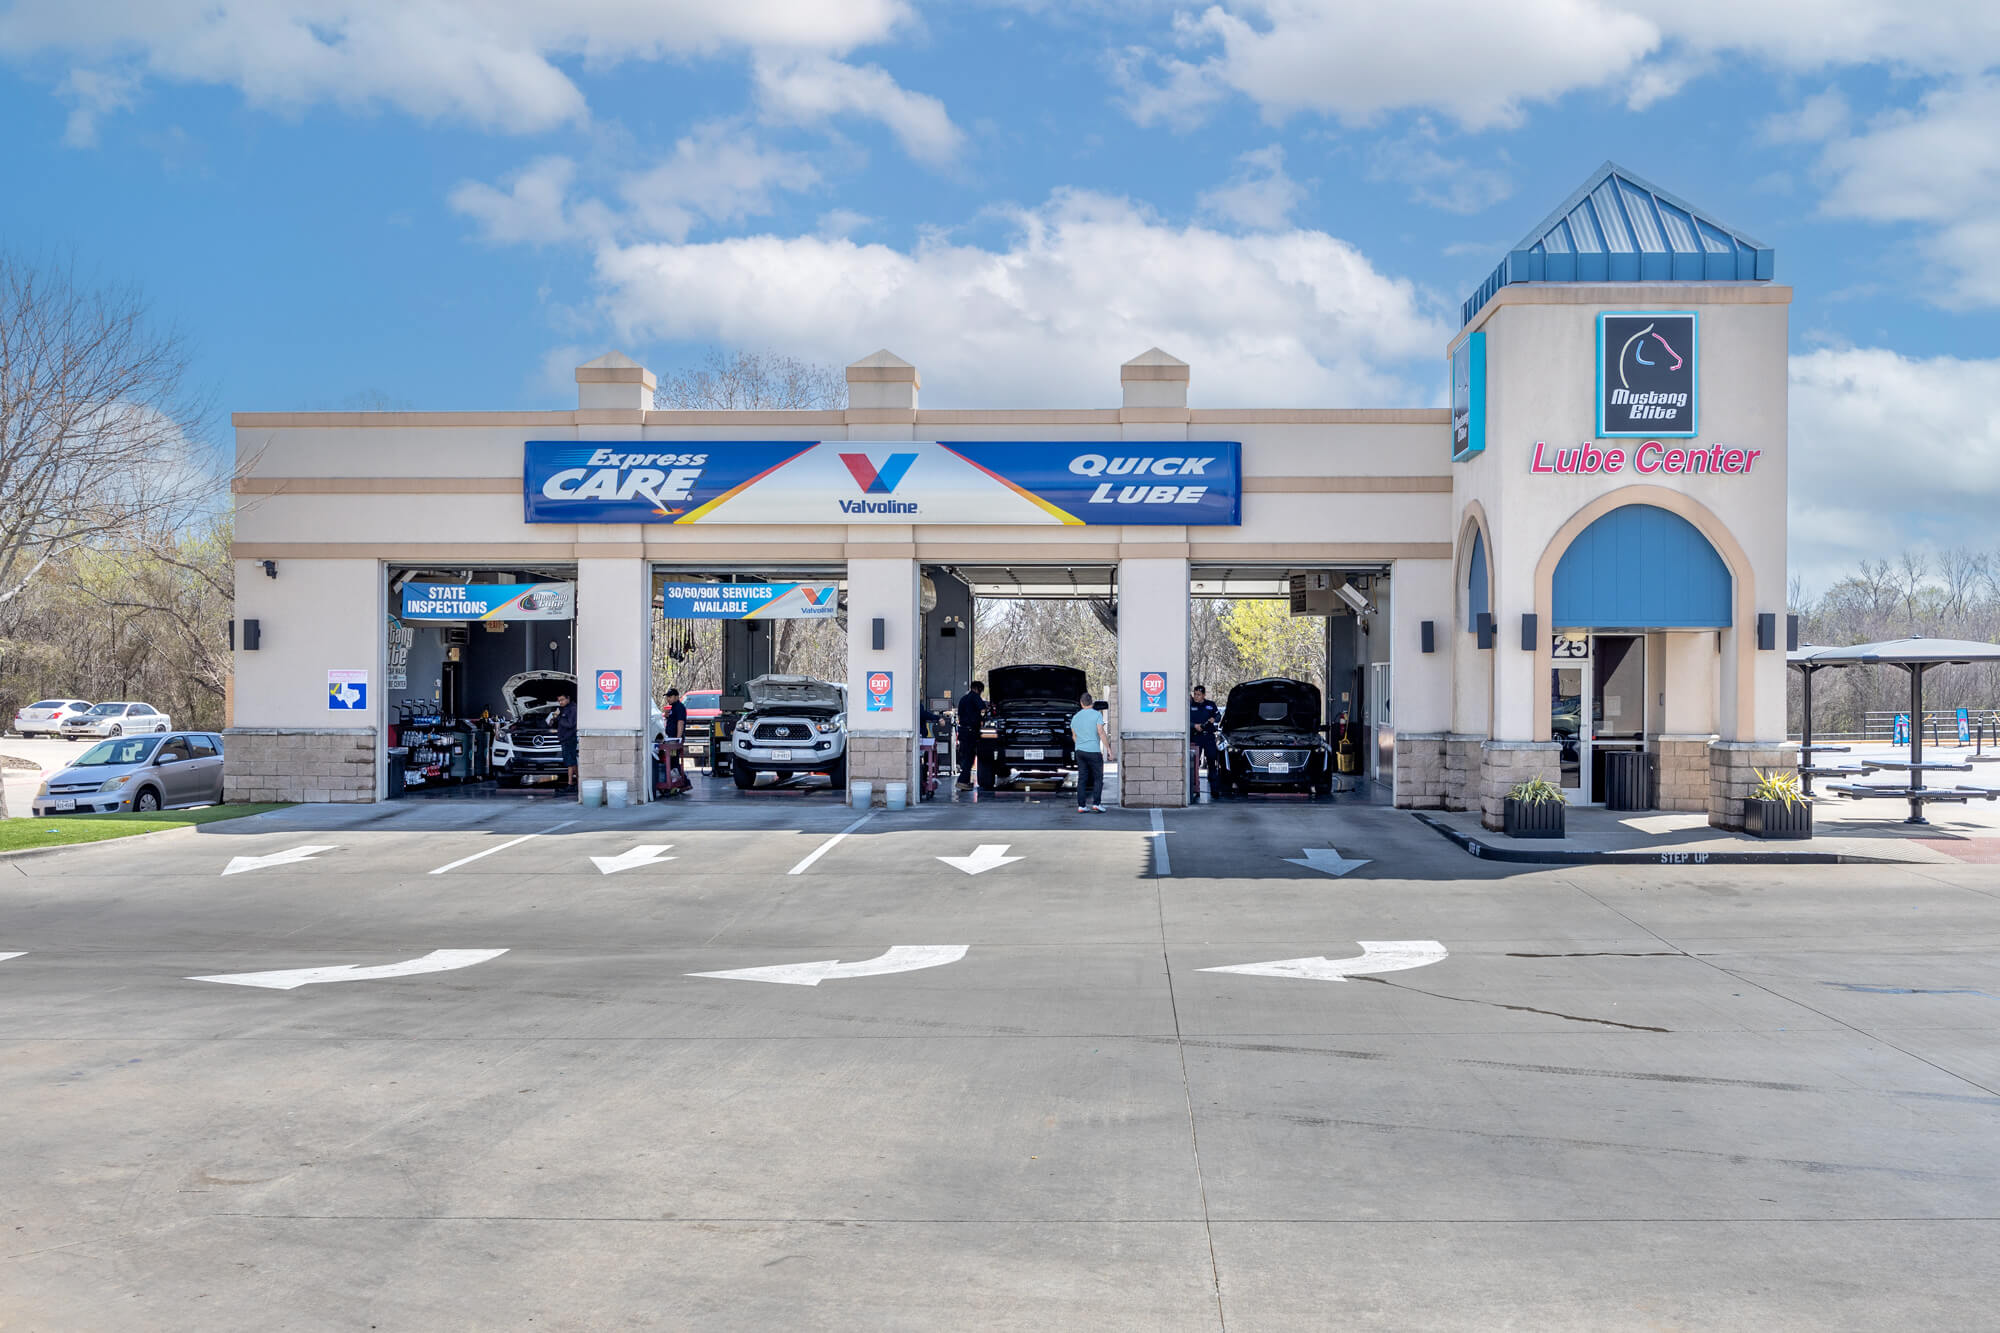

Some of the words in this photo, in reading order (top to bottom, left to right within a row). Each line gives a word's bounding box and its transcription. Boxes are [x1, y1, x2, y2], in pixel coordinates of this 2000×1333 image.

[1611, 388, 1688, 407] Mustang
[1629, 404, 1677, 419] Elite
[586, 449, 709, 469] Express
[1530, 441, 1626, 474] Lube
[1635, 440, 1761, 474] Center
[1068, 454, 1216, 477] QUICK
[543, 468, 702, 512] CARE
[1088, 482, 1209, 504] LUBE
[838, 499, 918, 514] Valvoline
[428, 587, 466, 600] STATE
[668, 587, 720, 600] 30/60/90K
[722, 587, 773, 599] SERVICES
[407, 600, 488, 614] INSPECTIONS
[692, 601, 748, 613] AVAILABLE
[388, 625, 414, 649] tang
[1554, 635, 1587, 657] 25
[600, 678, 617, 687] EXIT
[871, 679, 888, 688] EXIT
[1145, 680, 1161, 688] EXIT
[1660, 852, 1689, 864] STEP
[1694, 852, 1709, 864] UP
